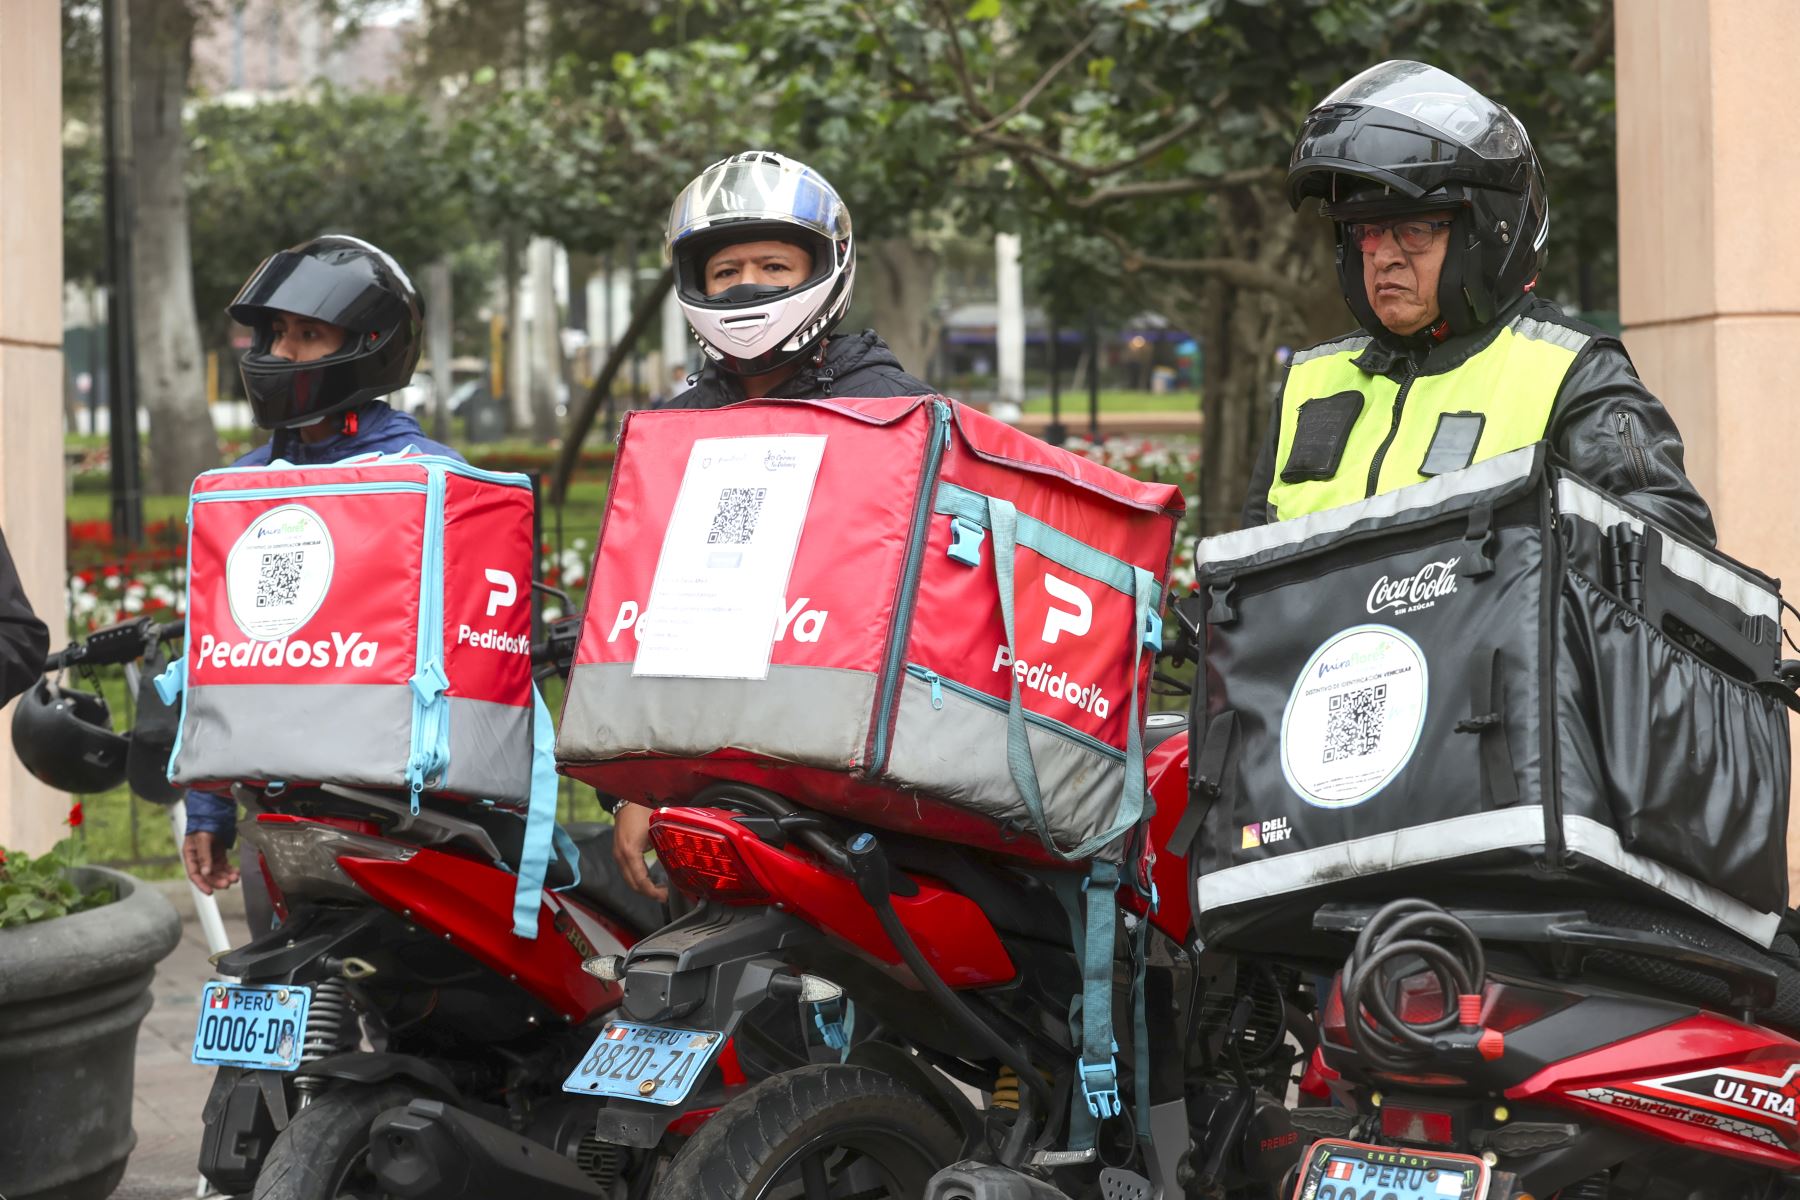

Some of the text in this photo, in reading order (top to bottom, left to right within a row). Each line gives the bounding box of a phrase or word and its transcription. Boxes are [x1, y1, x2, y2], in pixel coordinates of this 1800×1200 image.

[1366, 556, 1461, 614] Coca-Cola
[1394, 601, 1435, 616] SIN AZÚCAR
[197, 632, 378, 669] PedidosYa
[458, 624, 530, 655] PedidosYa
[992, 644, 1109, 719] PedidosYa
[1262, 816, 1287, 833] DELI
[1262, 827, 1292, 844] VERY
[581, 1042, 696, 1088] 8820-ZA
[1611, 1095, 1689, 1120] COMFORT
[1713, 1079, 1795, 1117] ULTRA
[1260, 1131, 1298, 1152] PREMIER
[1367, 1152, 1429, 1168] ENERGY
